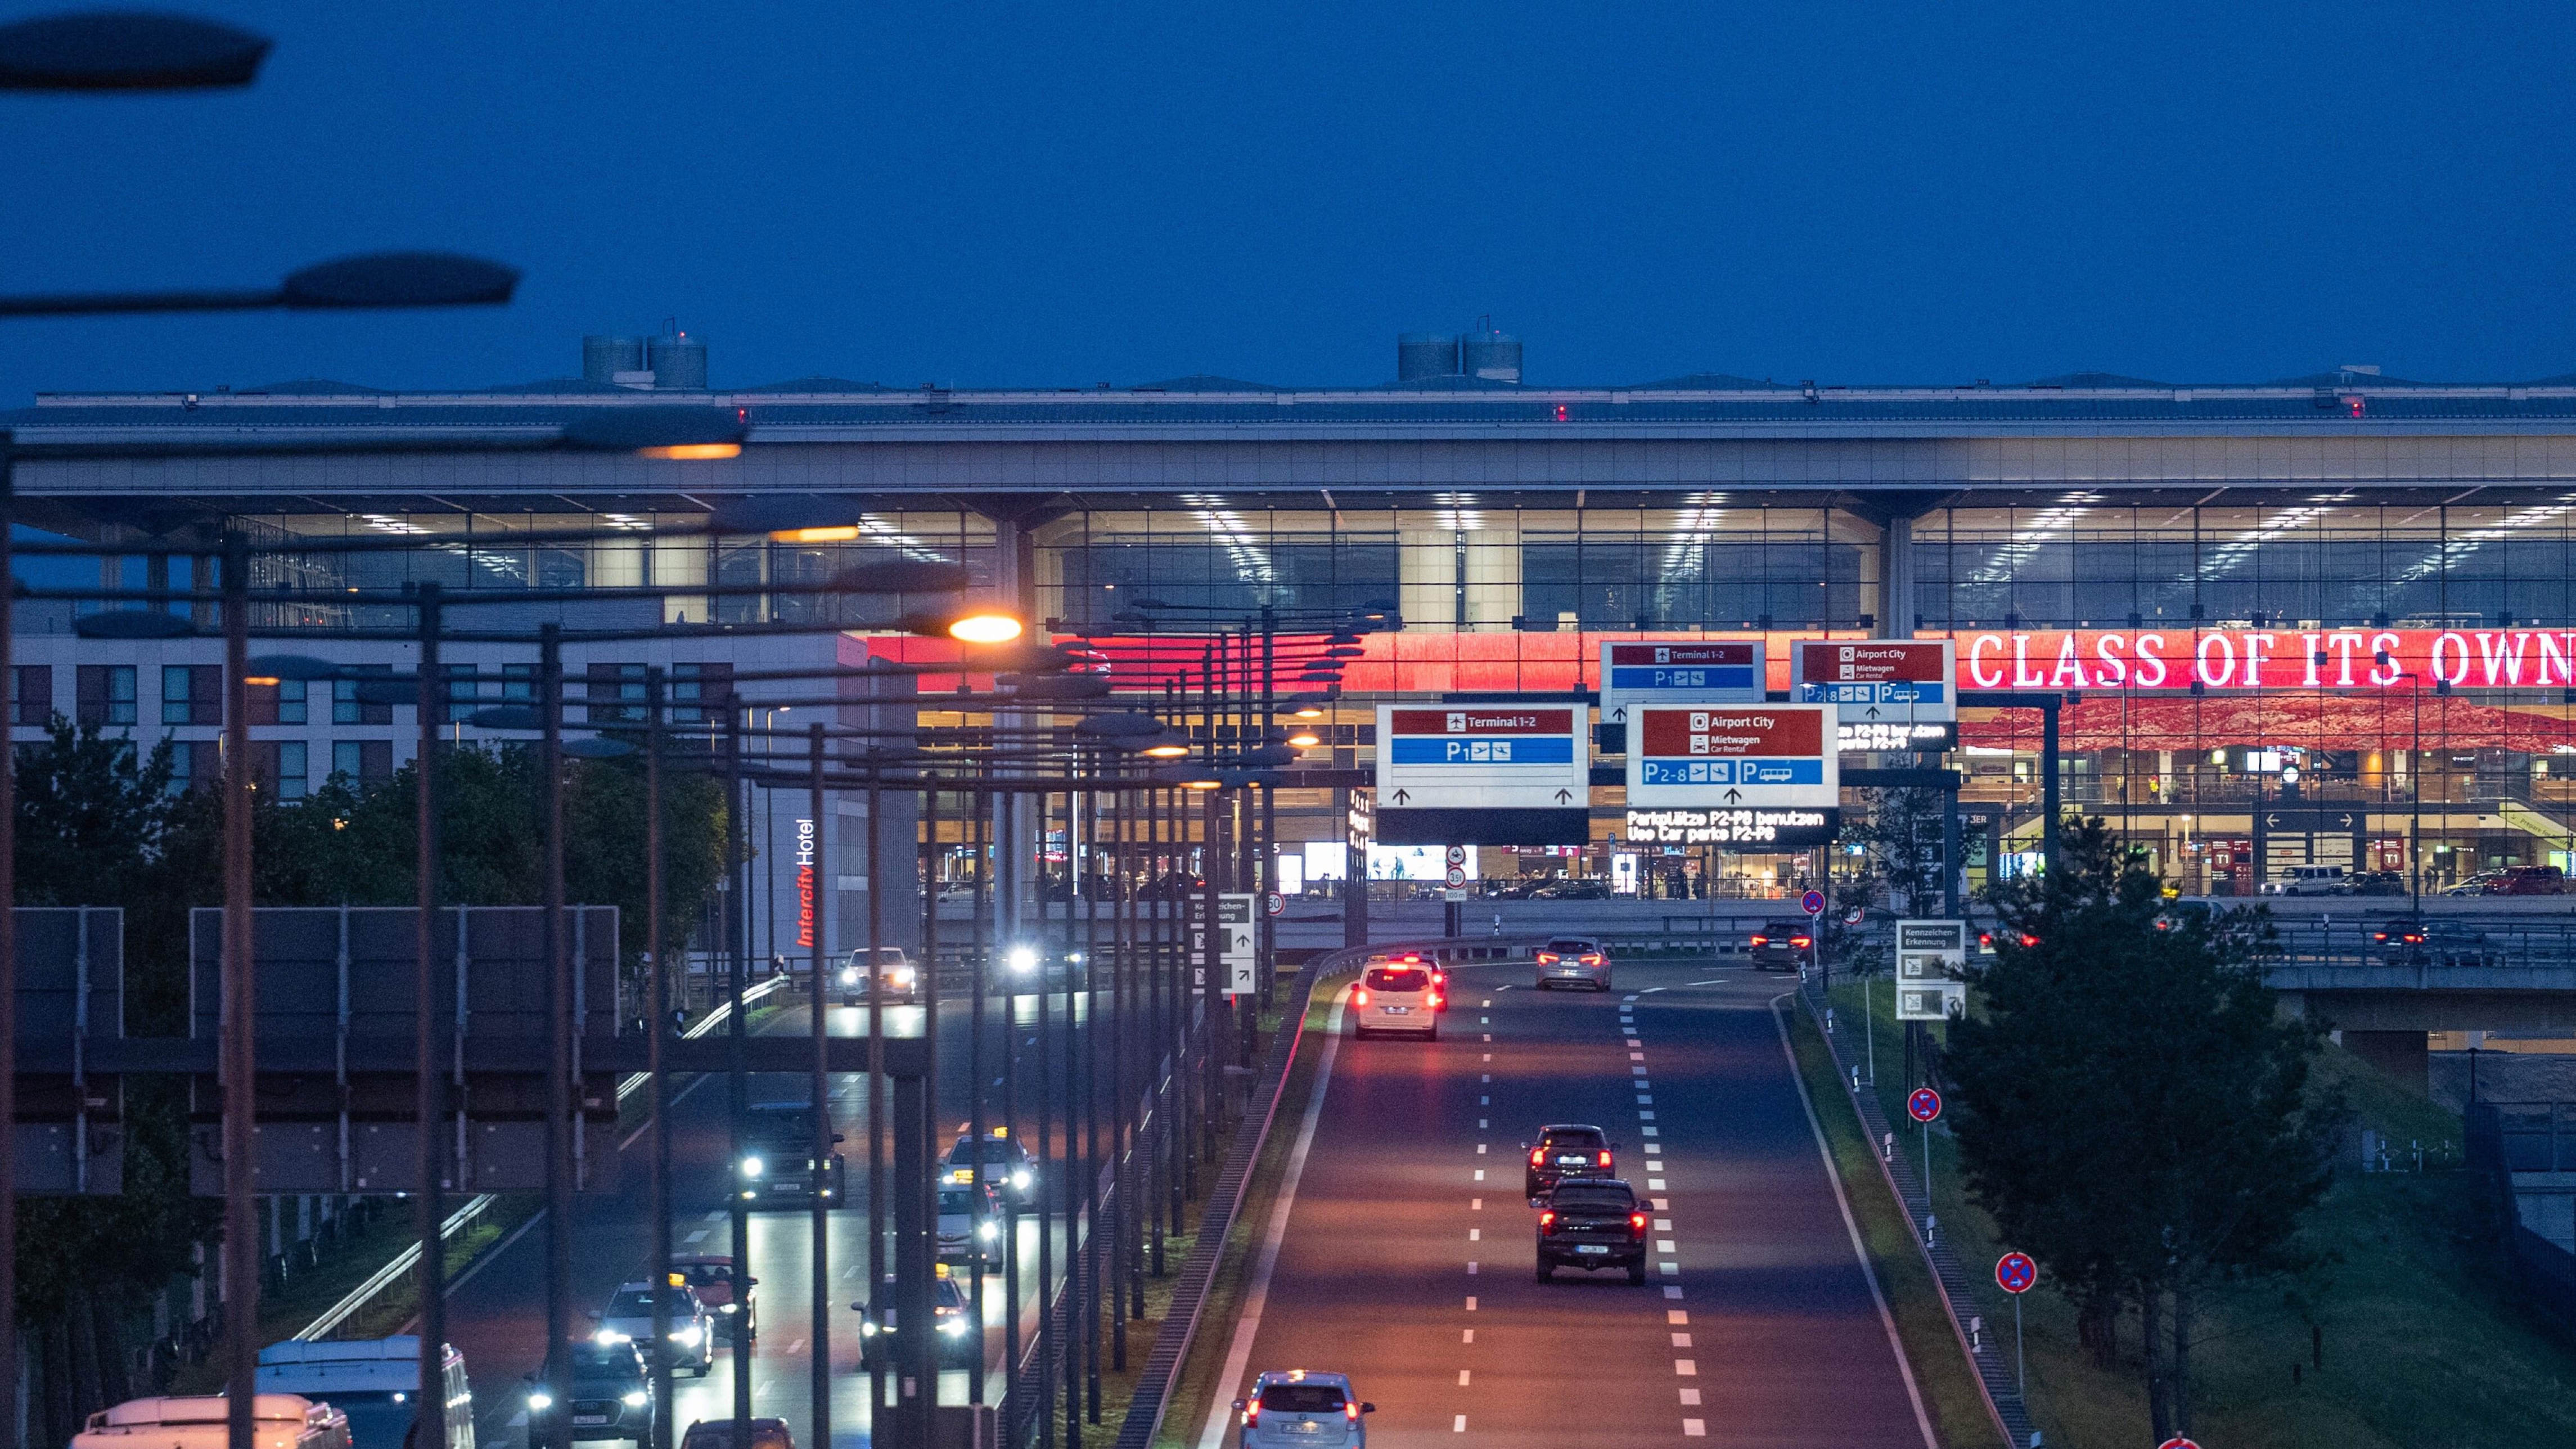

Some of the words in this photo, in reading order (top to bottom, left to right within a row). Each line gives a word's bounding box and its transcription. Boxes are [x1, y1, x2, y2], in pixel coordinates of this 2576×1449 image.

[1856, 650, 1887, 660] Airport
[1889, 650, 1906, 660] City
[1970, 634, 2167, 686] CLASS
[2197, 633, 2275, 686] OF
[2303, 633, 2401, 686] ITS
[2431, 633, 2576, 686] OWN
[1881, 686, 1892, 701] P
[1468, 717, 1517, 727] Terminal
[1519, 717, 1536, 727] 1-2
[1711, 717, 1751, 729] Airport
[1753, 717, 1775, 729] City
[1711, 736, 1760, 745] Mietwagen
[1744, 763, 1757, 781] P
[1755, 811, 1824, 826] benutzen
[1627, 826, 1655, 841] Use
[1659, 826, 1685, 841] Car
[2216, 854, 2229, 864] T1
[2385, 854, 2398, 863] T1
[1906, 938, 1946, 947] Erkennung
